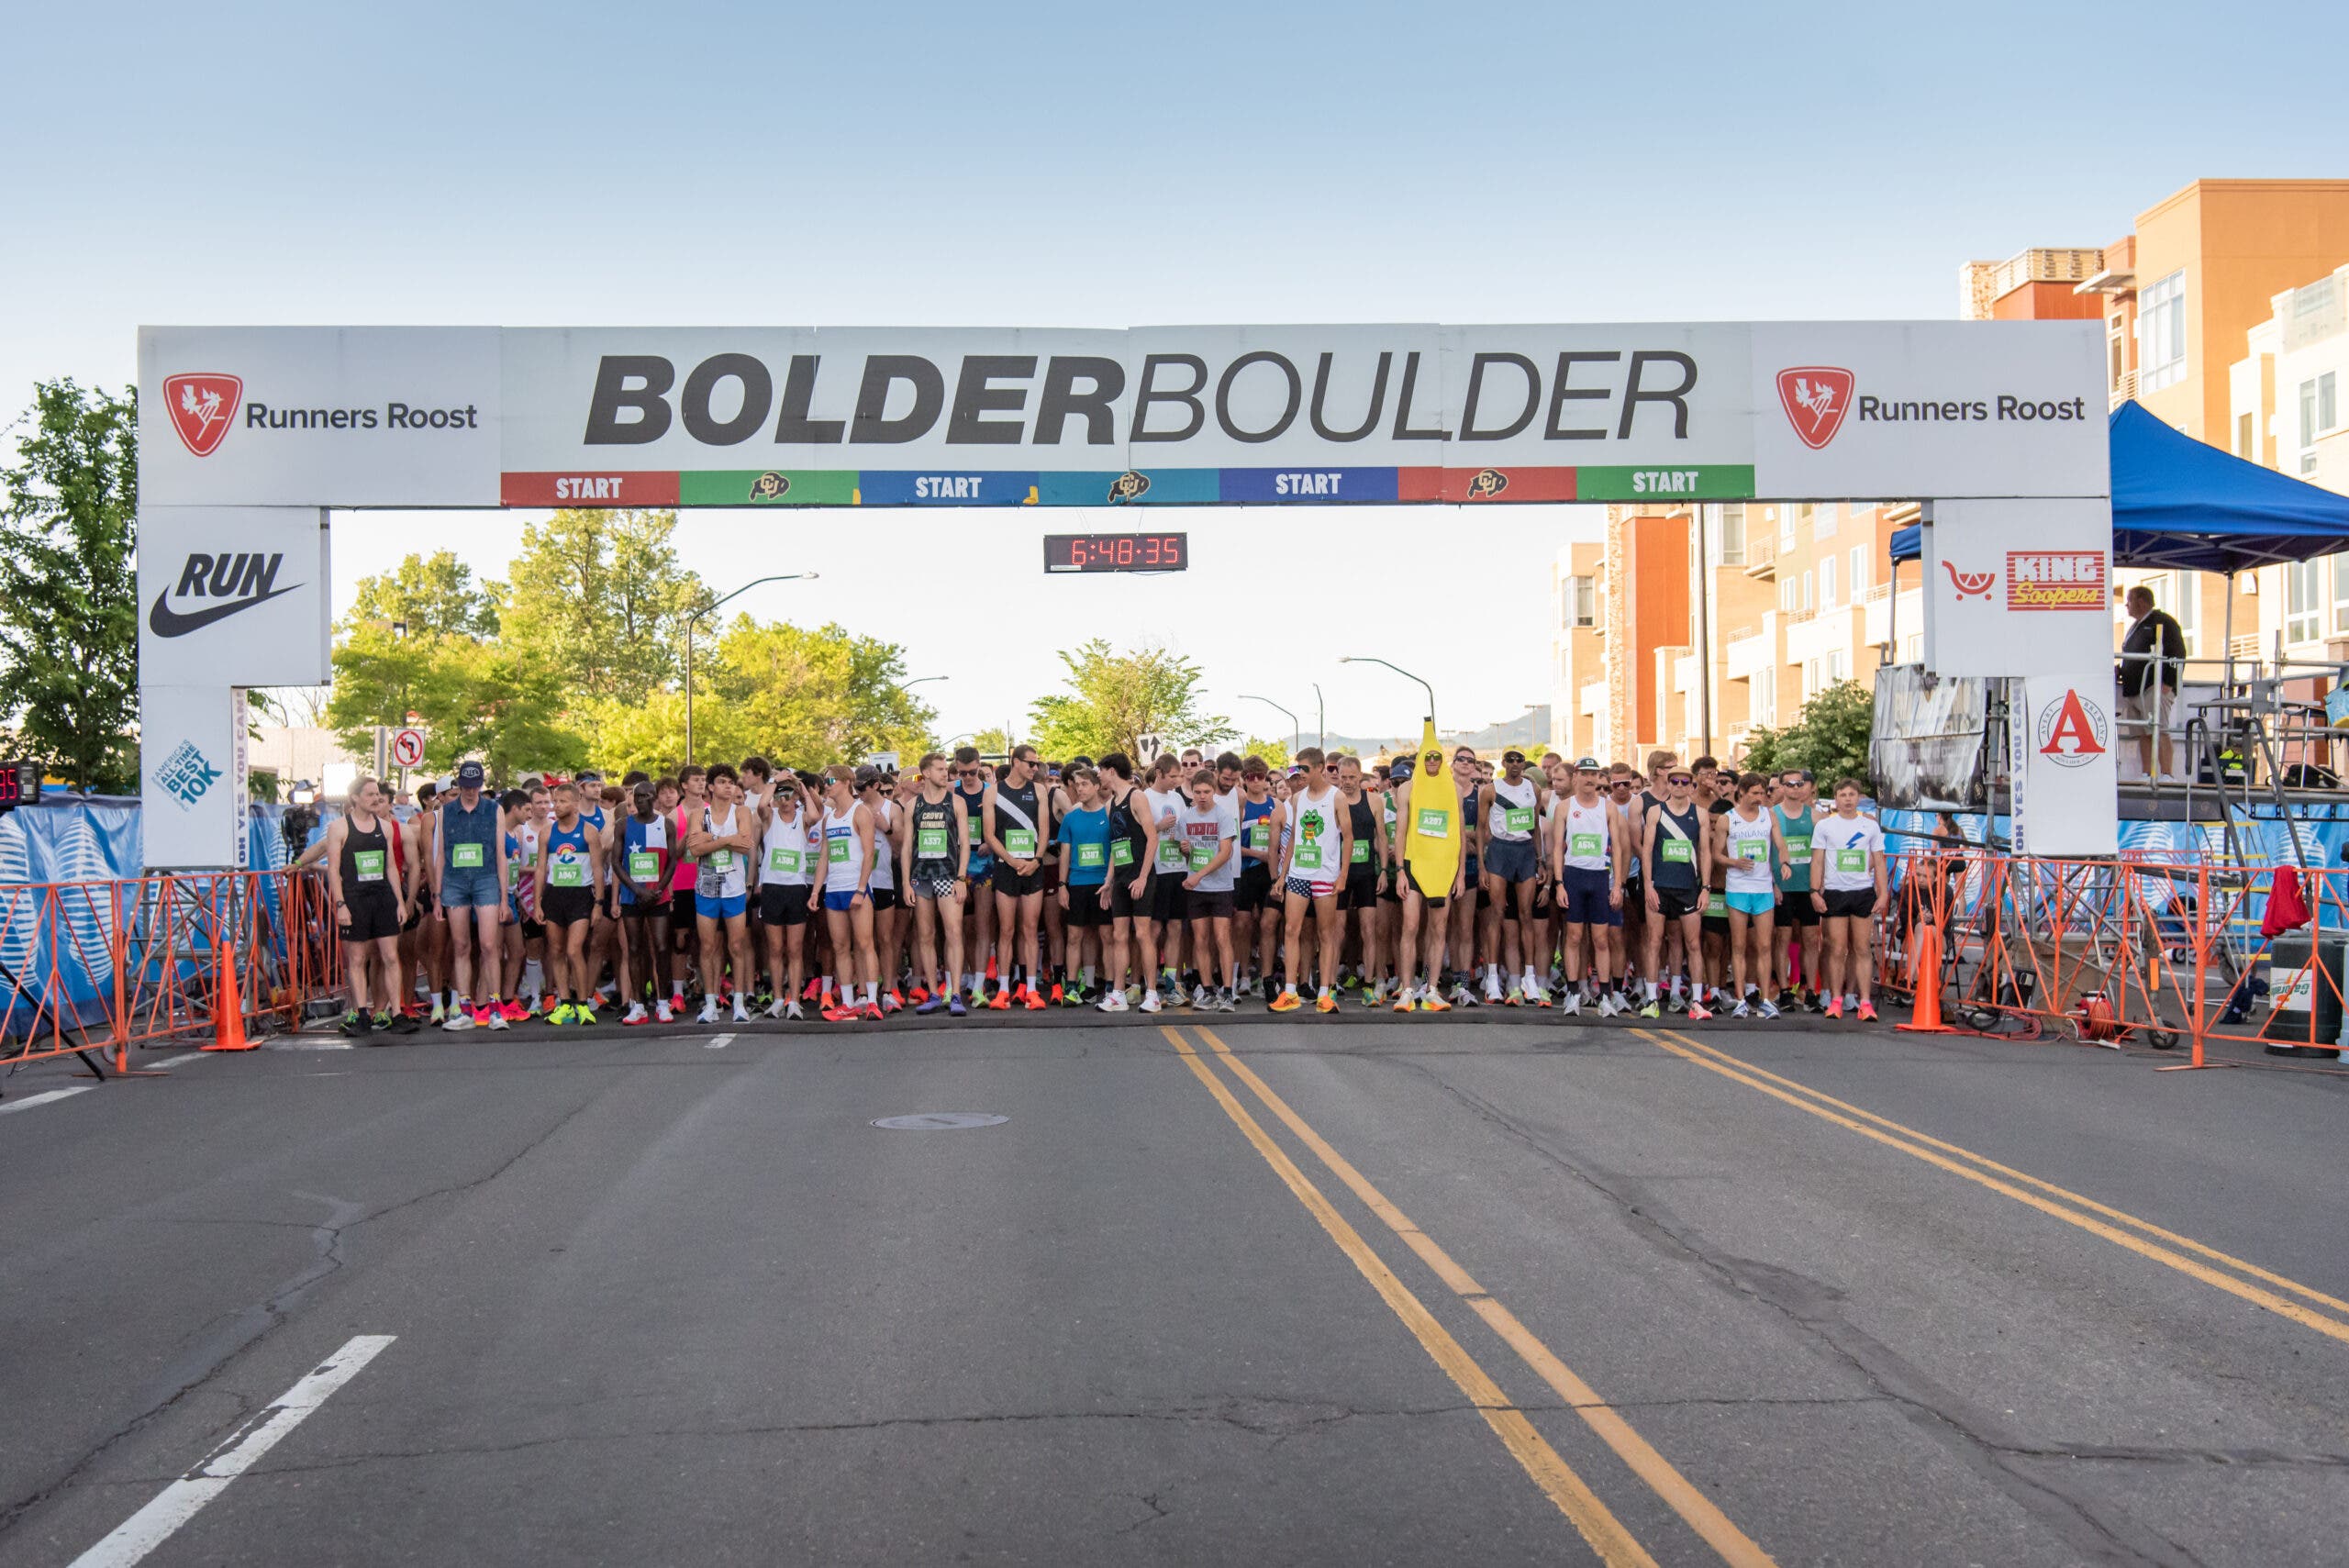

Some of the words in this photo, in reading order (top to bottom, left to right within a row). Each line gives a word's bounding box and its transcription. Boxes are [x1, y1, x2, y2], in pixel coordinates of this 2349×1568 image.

[584, 351, 1698, 446] BOLDERBOULDER
[1860, 396, 1987, 420] Runners
[1998, 395, 2085, 420] Roost
[247, 404, 377, 428] Runners
[388, 404, 477, 428] Roost
[556, 478, 622, 500] START
[916, 477, 982, 498] START
[1275, 473, 1341, 495] START
[1632, 471, 1698, 493] START
[174, 552, 284, 597] RUN
[2015, 557, 2097, 582] KING
[2013, 581, 2099, 609] Soopers
[2040, 689, 2106, 753] A
[154, 740, 190, 778] AMERICA'S
[161, 744, 196, 784] ALL-TIME
[237, 746, 245, 785] YOU
[2013, 735, 2022, 774] YOU
[166, 750, 205, 794] BEST
[180, 761, 223, 805] 10K
[238, 793, 246, 830] YES
[2014, 780, 2023, 818] YES
[920, 820, 945, 828] RUNNING
[922, 812, 944, 820] CROWN
[1734, 829, 1768, 838] FINLAND
[2015, 824, 2024, 851] OH
[239, 837, 246, 863] OH
